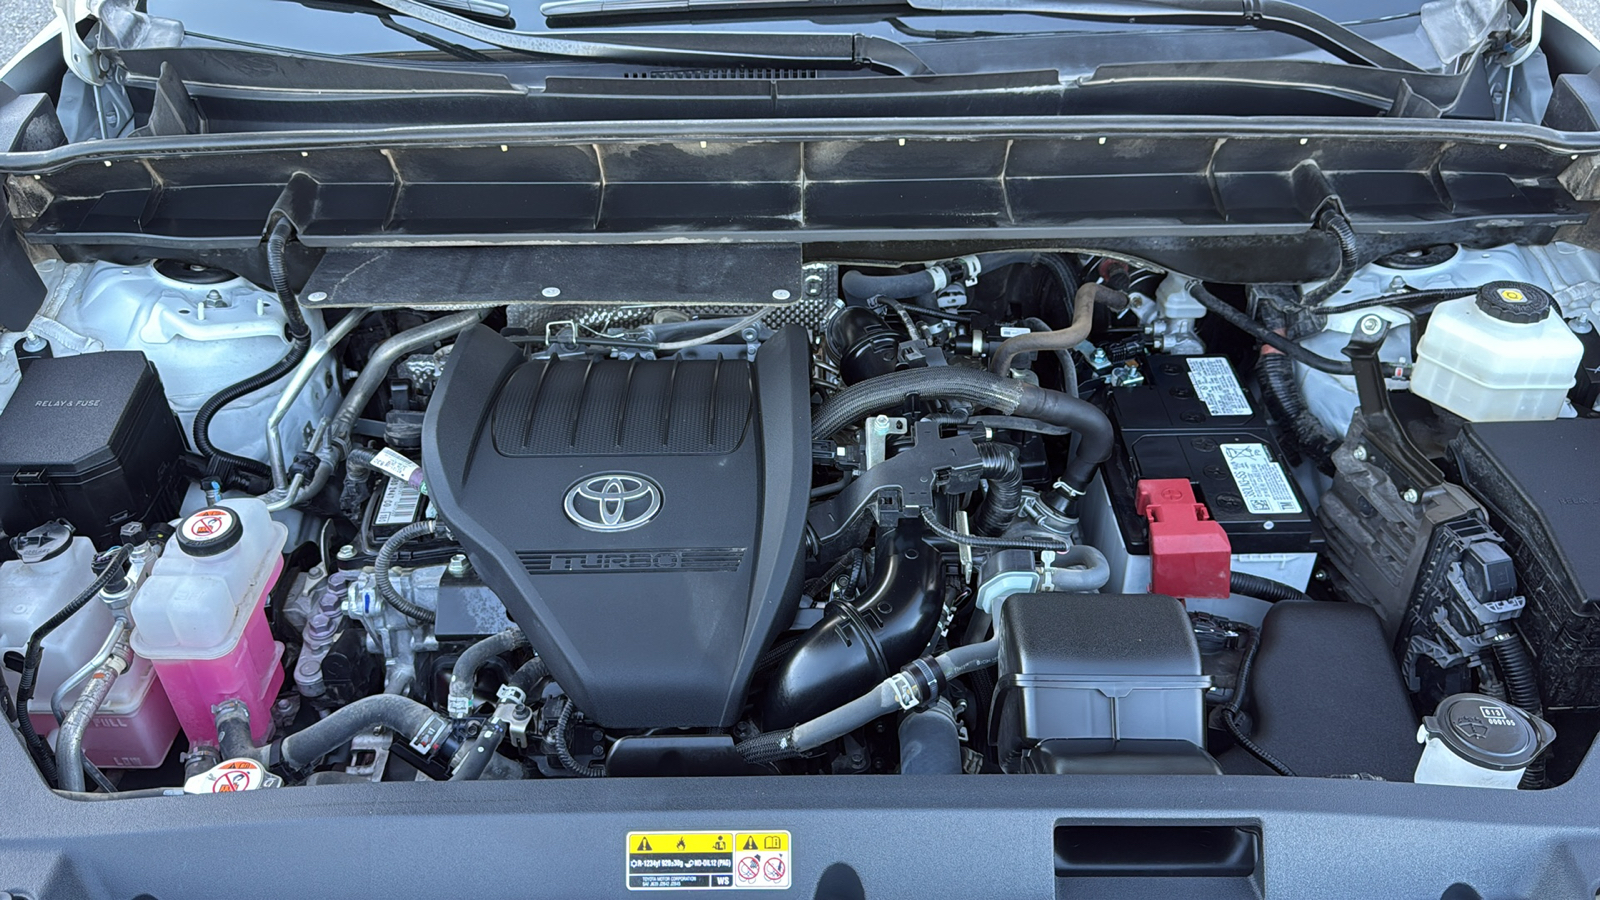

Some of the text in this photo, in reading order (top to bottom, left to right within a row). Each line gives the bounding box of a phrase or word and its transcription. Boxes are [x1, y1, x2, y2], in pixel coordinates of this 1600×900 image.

[554, 552, 679, 569] TURBO
[92, 718, 128, 728] FULL
[113, 756, 142, 766] LOW
[716, 876, 730, 885] WS
